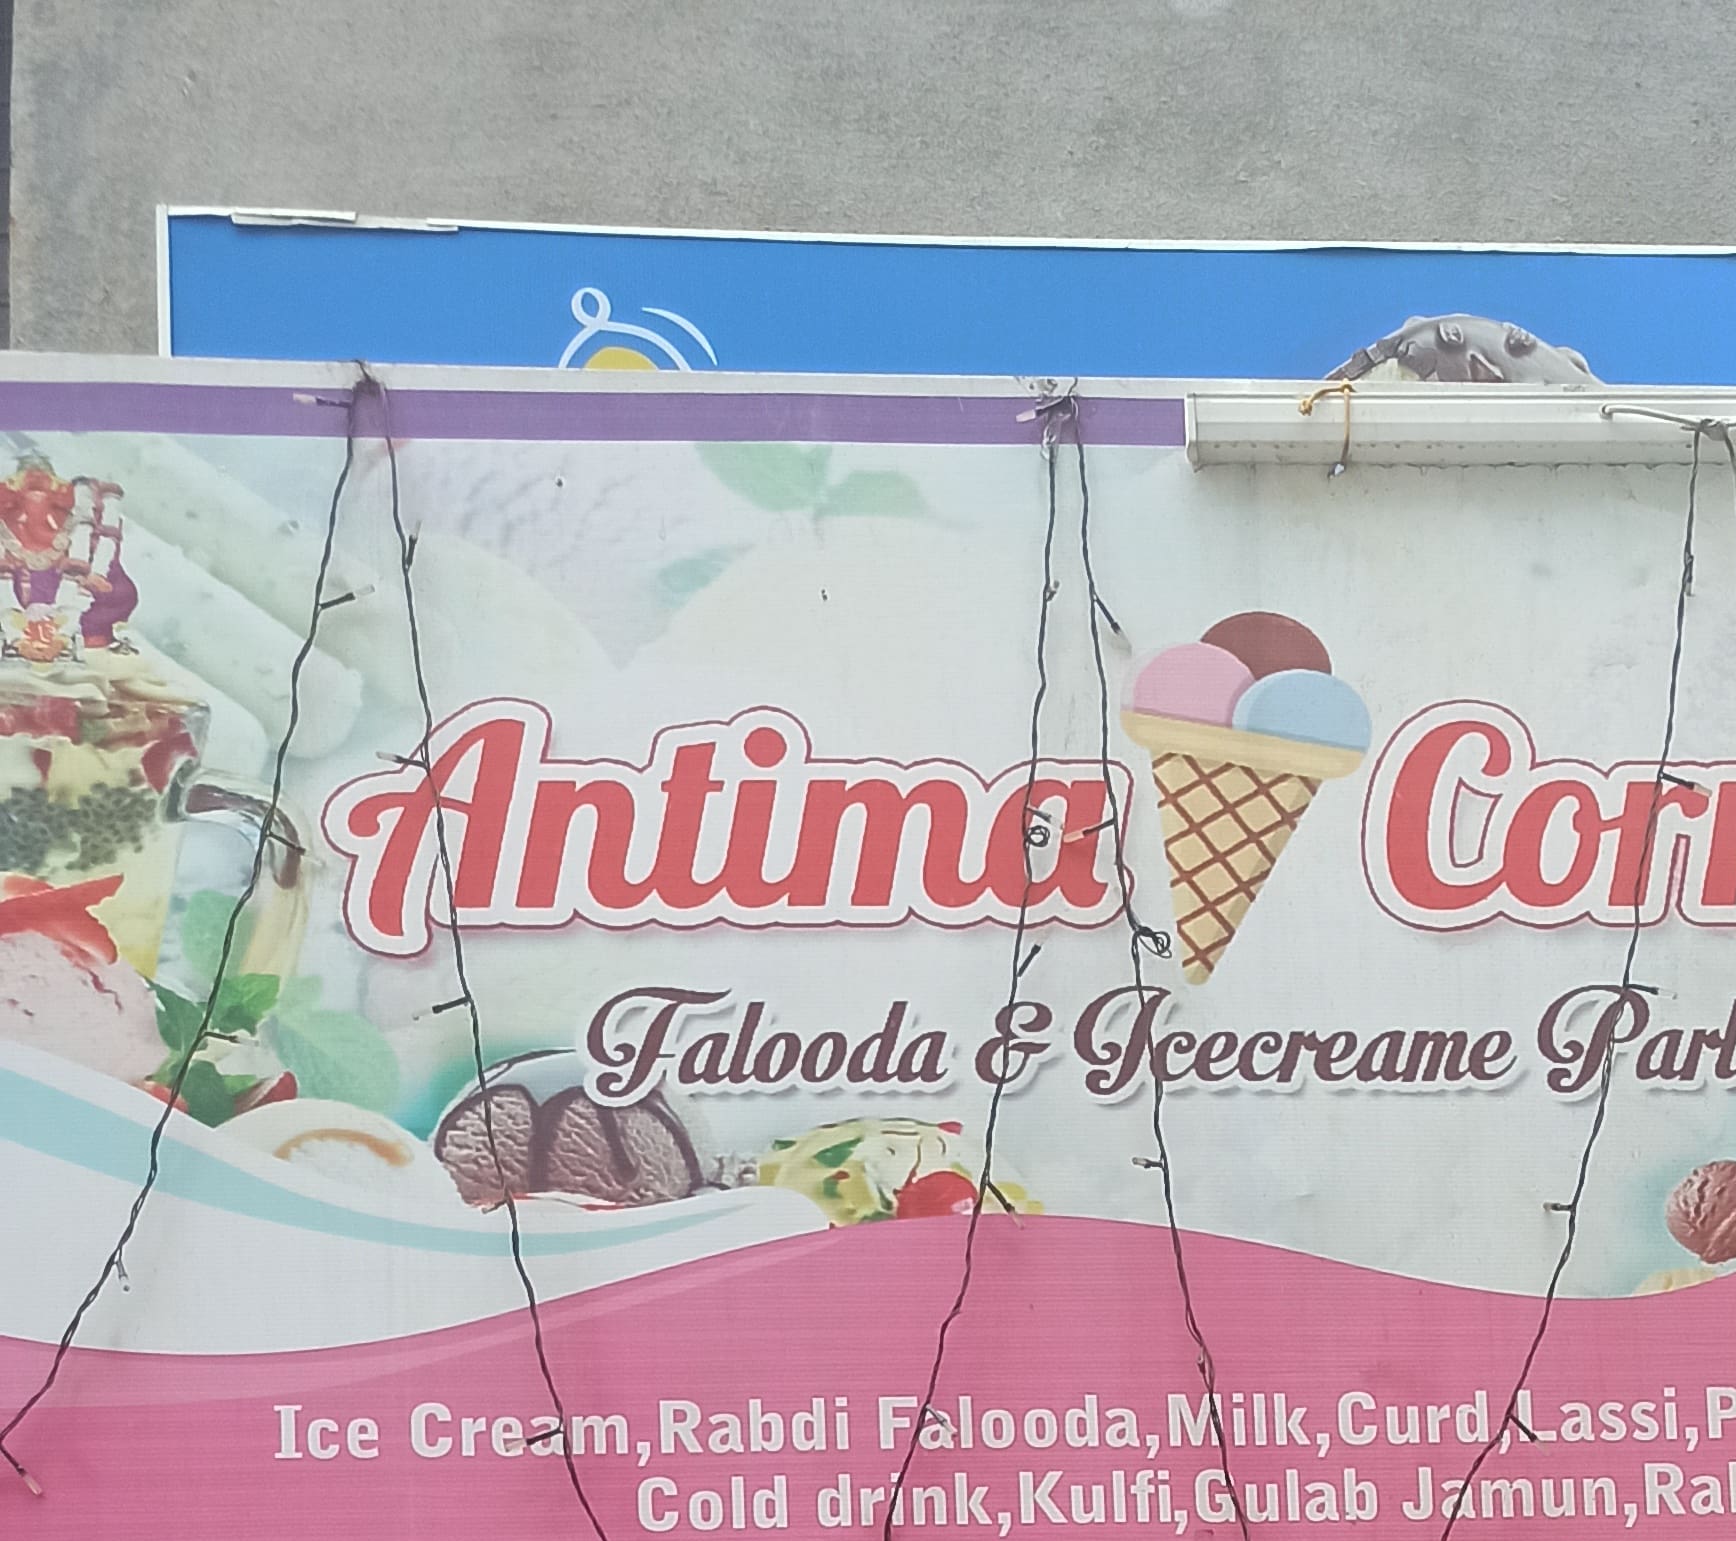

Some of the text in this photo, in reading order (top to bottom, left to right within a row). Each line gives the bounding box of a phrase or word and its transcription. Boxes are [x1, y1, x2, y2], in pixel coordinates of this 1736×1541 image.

[334, 708, 1122, 946] Antima
[592, 985, 947, 1096] Falooda
[975, 1000, 1056, 1087] &
[273, 1403, 380, 1461] Ice
[636, 1475, 788, 1534] Cold
